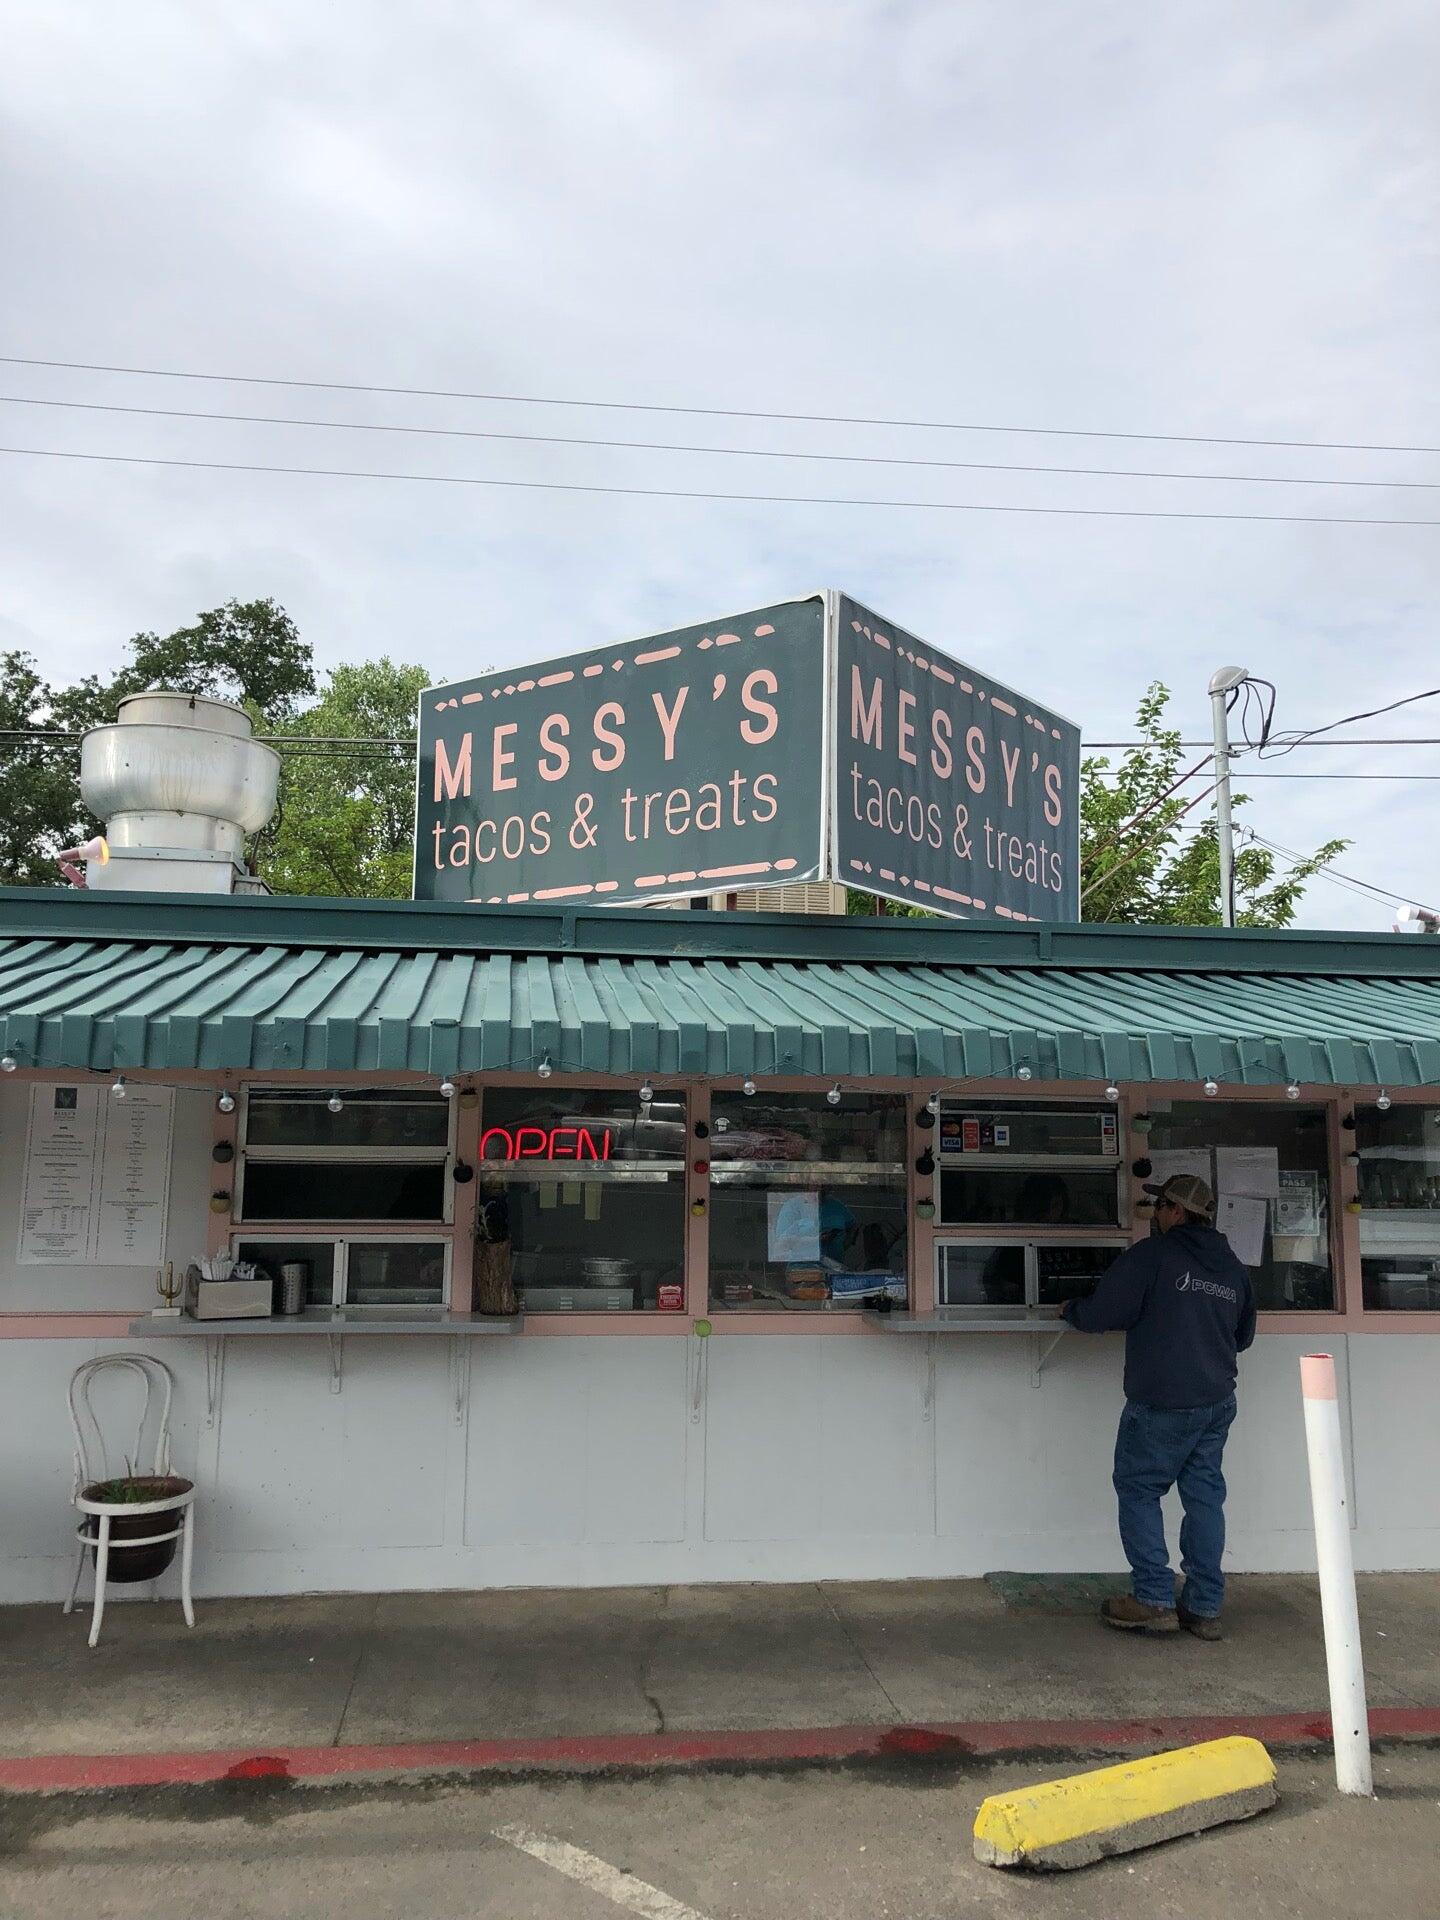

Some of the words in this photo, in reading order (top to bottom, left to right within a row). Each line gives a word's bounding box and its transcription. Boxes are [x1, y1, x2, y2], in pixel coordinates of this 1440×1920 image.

[434, 670, 778, 802] MESSY'S
[851, 664, 1062, 826] MESSY'S
[432, 811, 551, 870] tacos
[569, 793, 597, 850] &
[621, 769, 778, 842] treats
[850, 761, 943, 849] tacos
[953, 804, 973, 860] &
[984, 816, 1062, 893] treats
[480, 1127, 610, 1160] OPEN
[944, 1138, 960, 1146] VISA
[1282, 1179, 1306, 1187] PASS
[1191, 1278, 1236, 1303] PCWA
